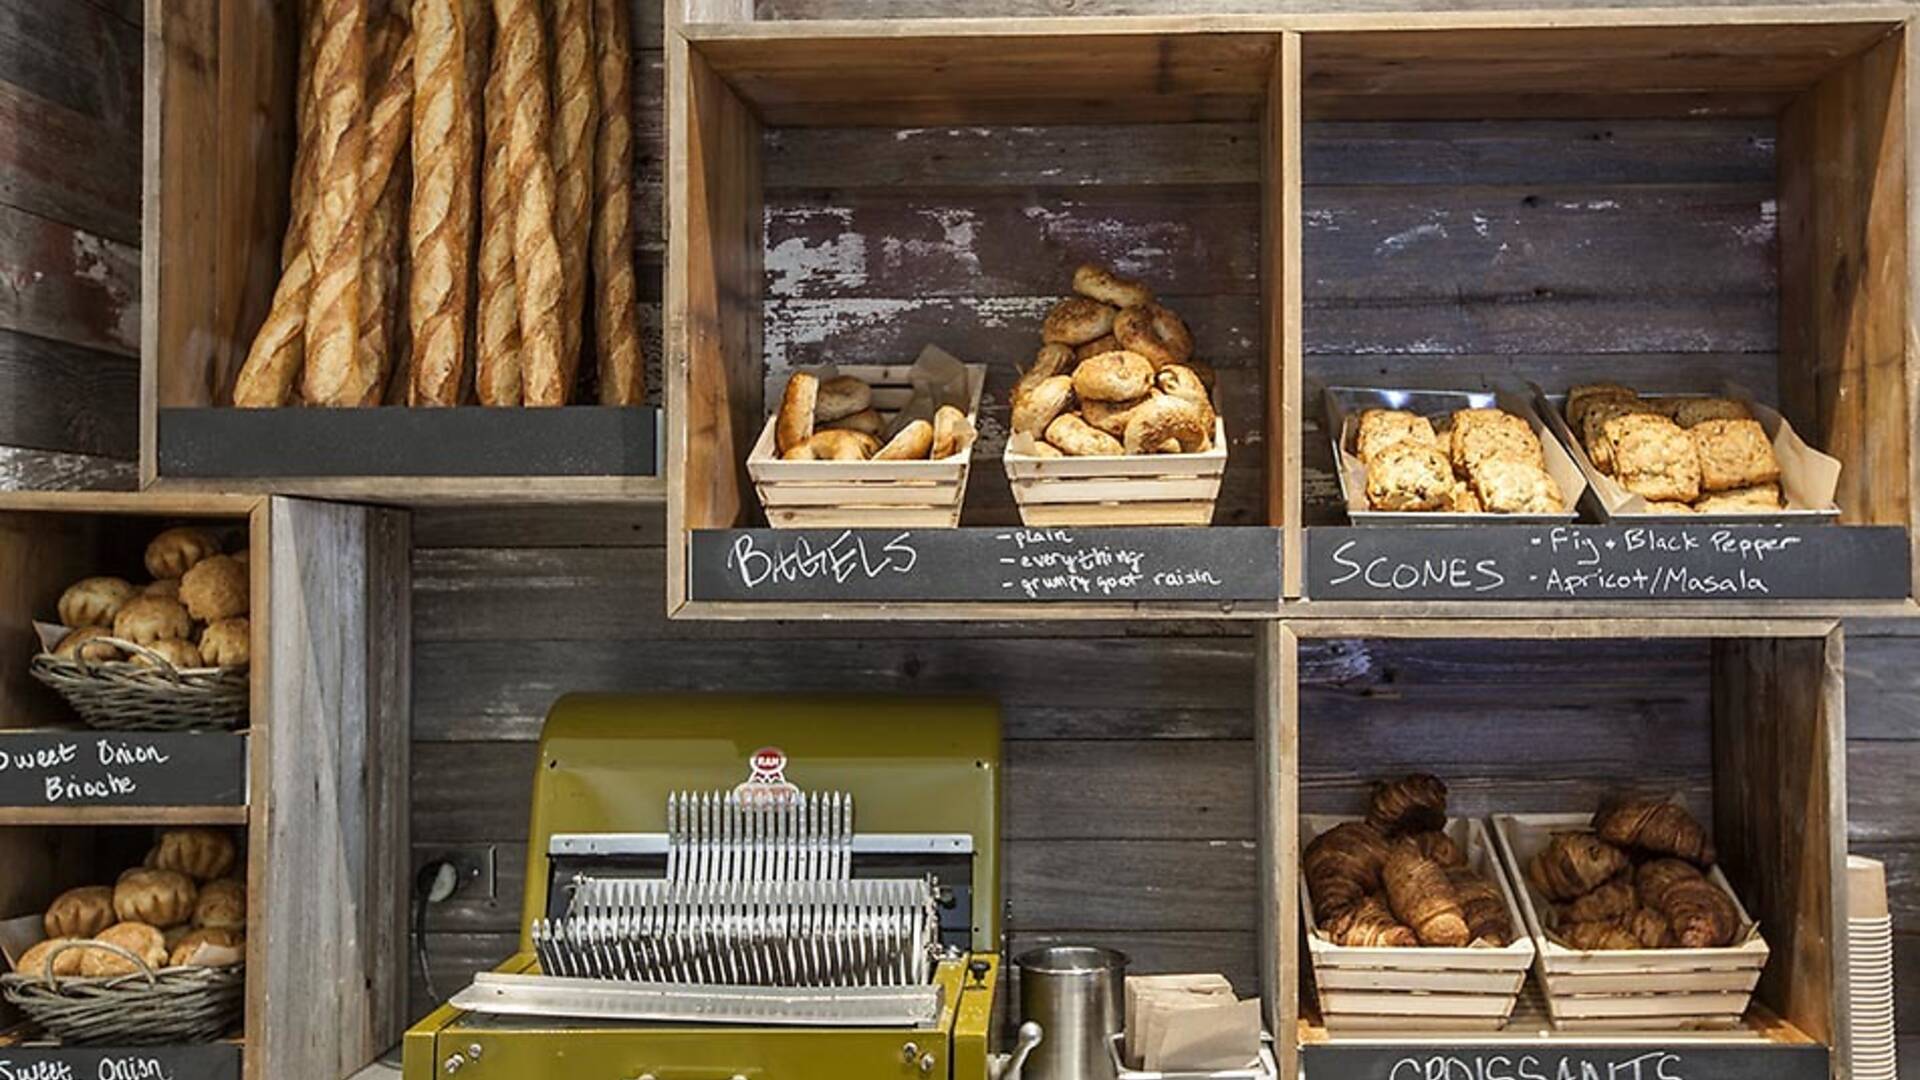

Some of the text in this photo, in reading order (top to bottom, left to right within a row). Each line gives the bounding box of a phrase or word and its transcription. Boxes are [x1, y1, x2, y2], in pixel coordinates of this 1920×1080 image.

[1015, 529, 1074, 549] plain
[1550, 527, 1600, 565] Fig
[1625, 528, 1699, 551] Black
[1711, 530, 1801, 561] Pepper
[727, 530, 917, 588] BAGELS
[1020, 546, 1144, 573] everything
[1330, 540, 1504, 592] SCONES
[1153, 568, 1222, 586] raisin
[1546, 566, 1769, 595] Apricot/Masala
[96, 739, 170, 765] Onion
[44, 772, 136, 802] Brioche
